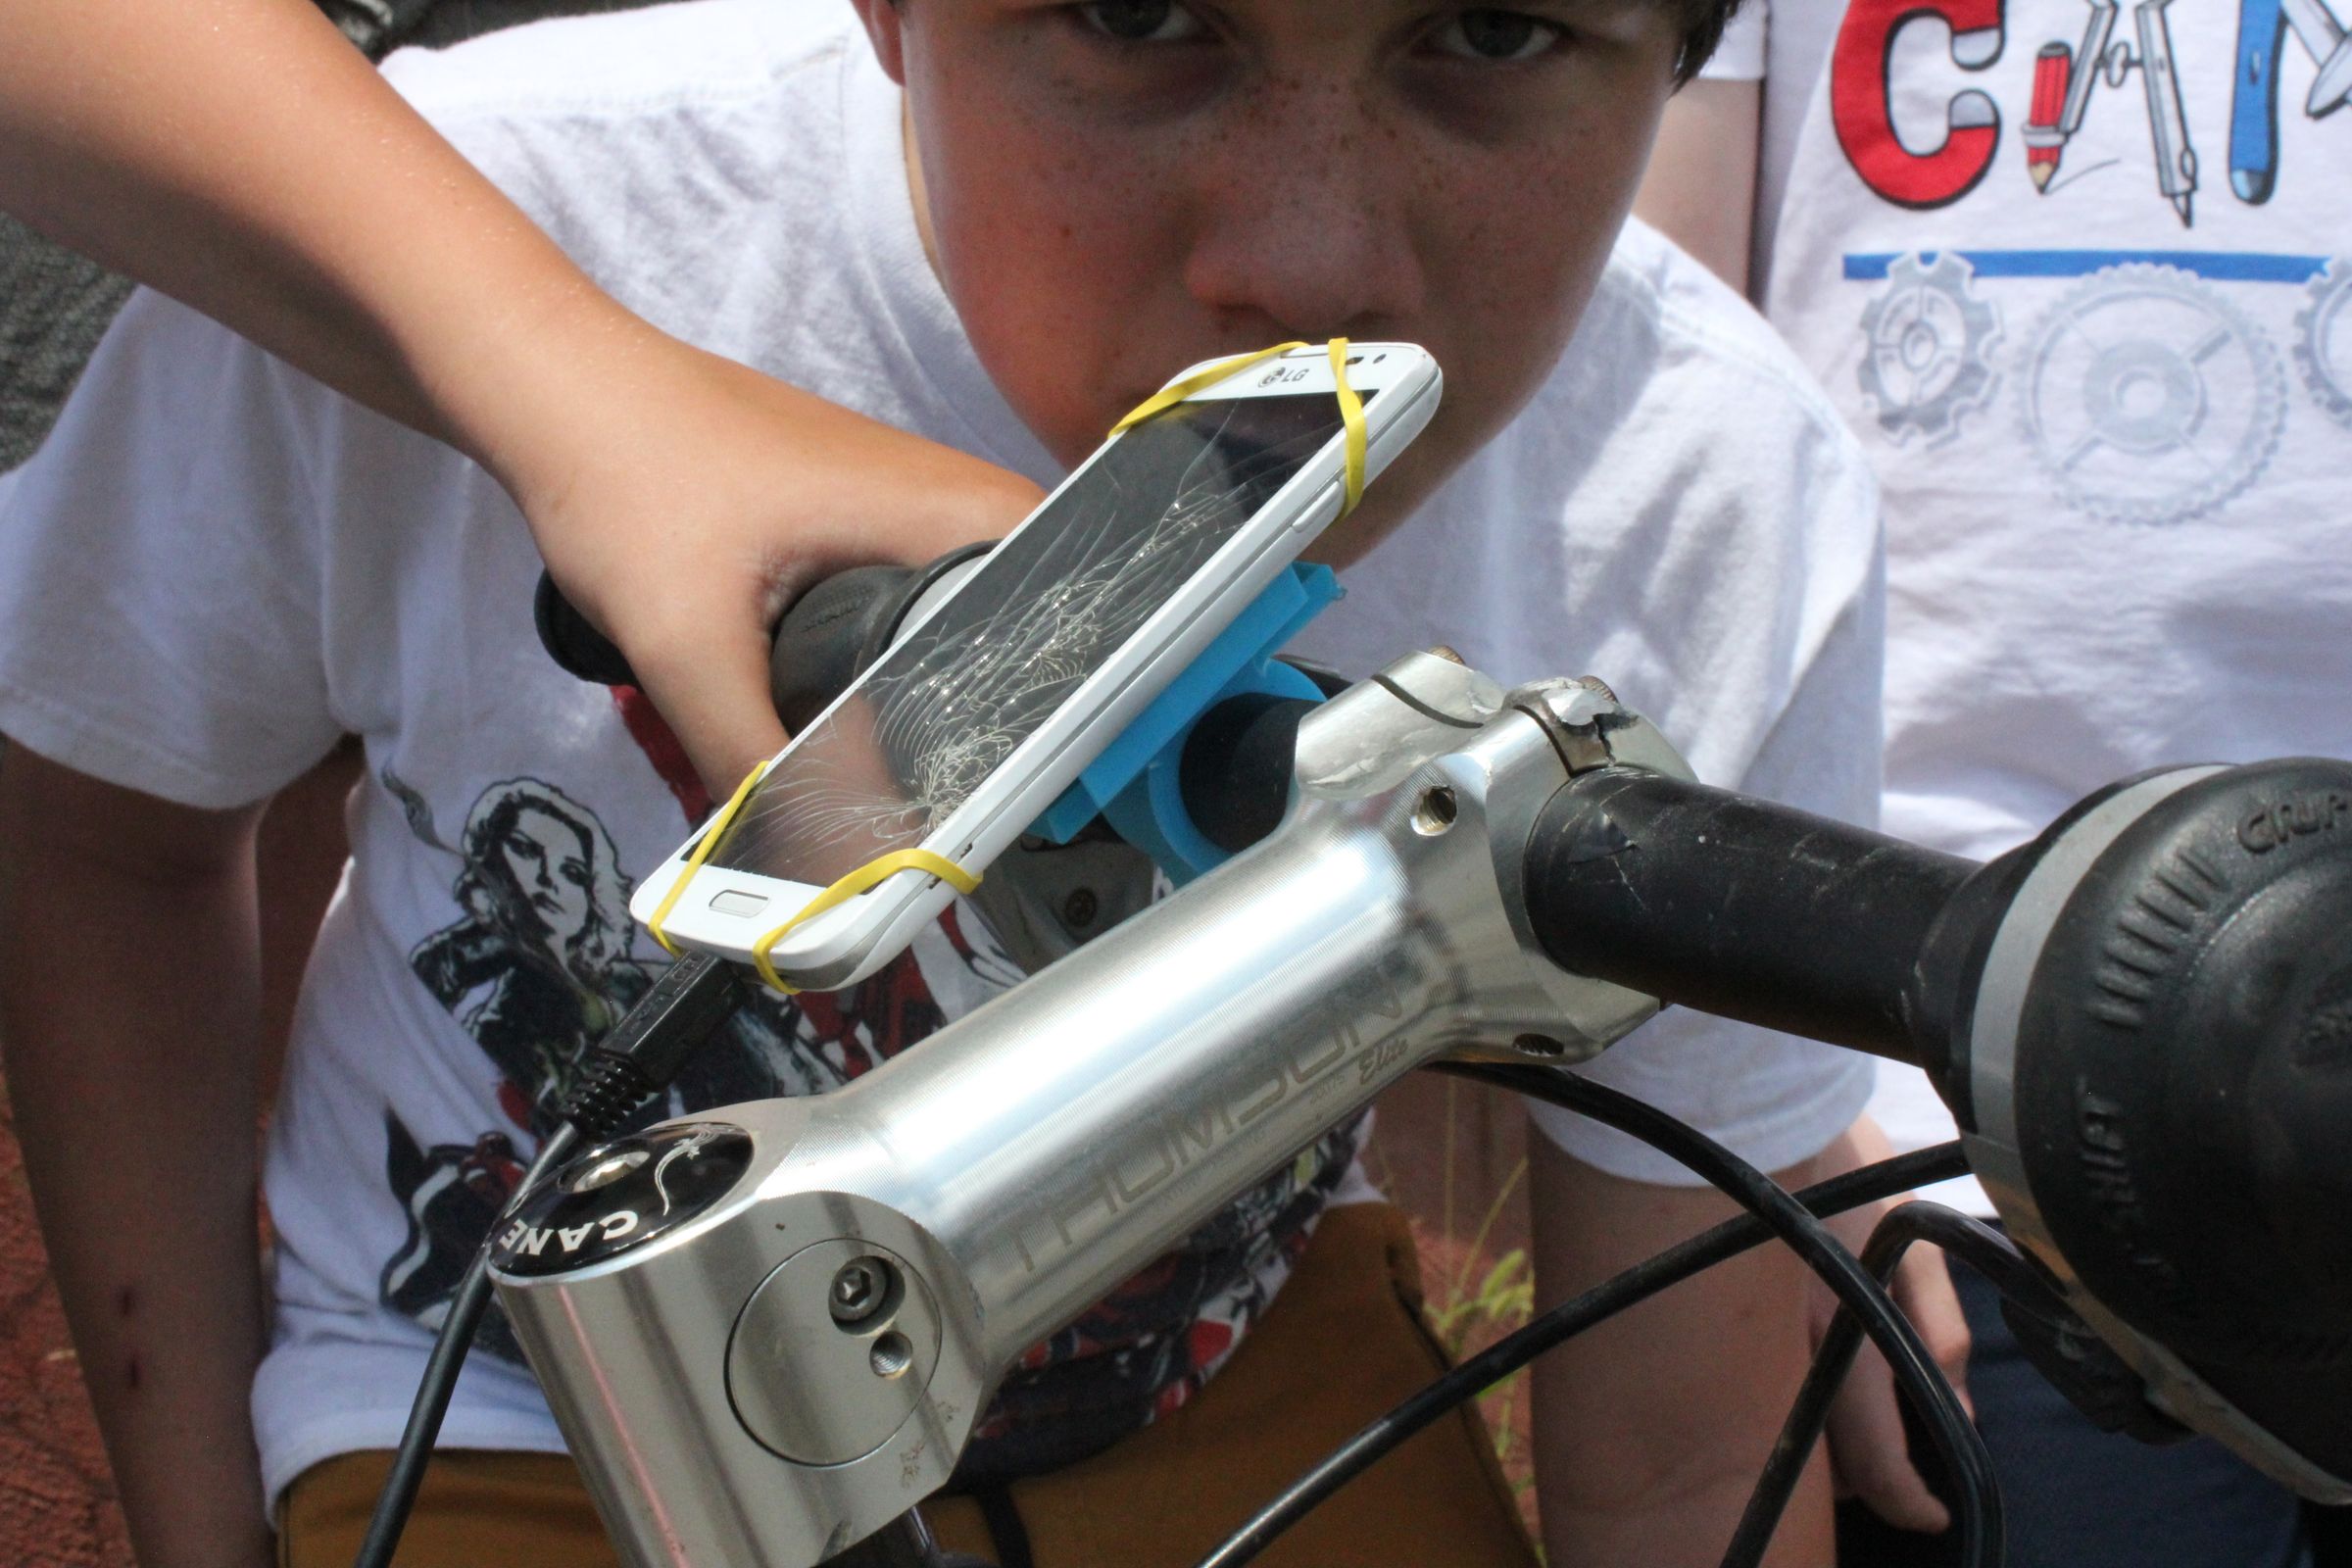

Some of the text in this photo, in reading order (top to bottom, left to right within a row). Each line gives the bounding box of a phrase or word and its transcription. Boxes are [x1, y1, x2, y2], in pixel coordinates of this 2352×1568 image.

[1281, 368, 1310, 383] LG
[1358, 1038, 1408, 1085] Elite
[988, 966, 1404, 1271] THOMSON
[499, 1209, 638, 1255] CANE
